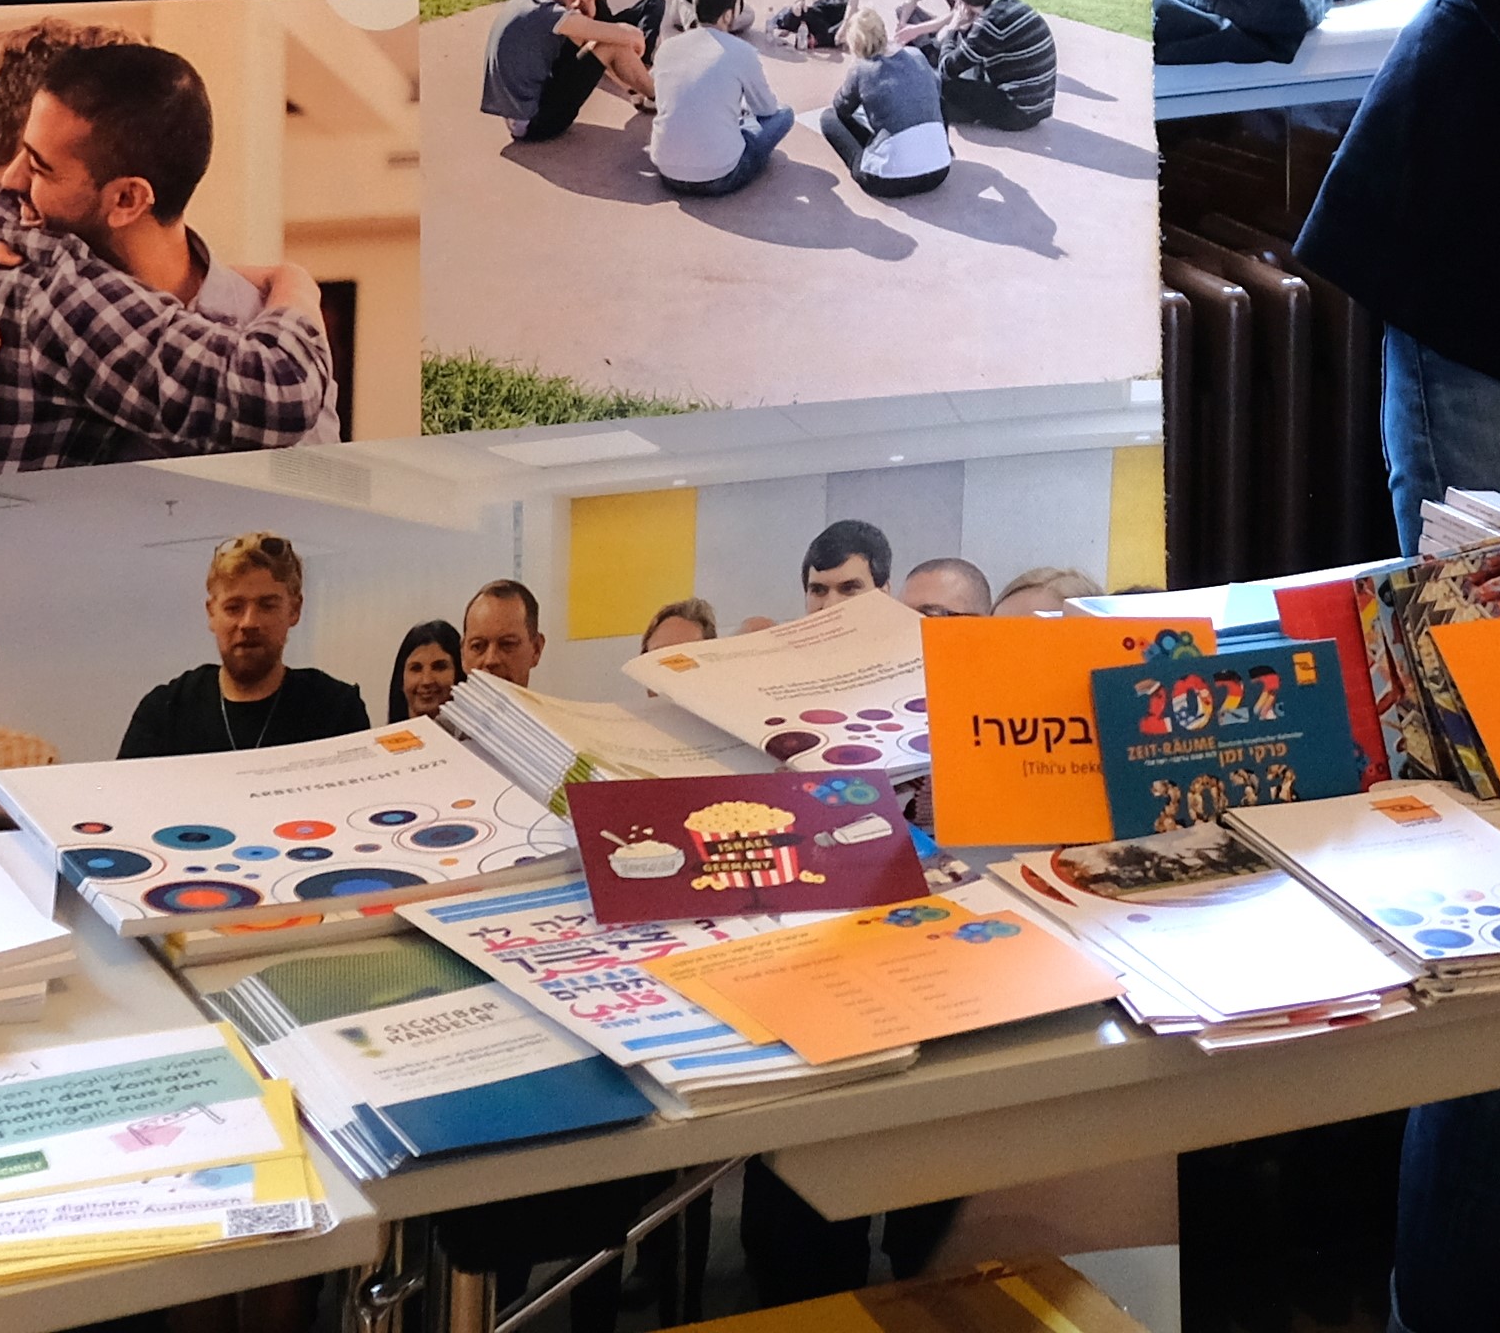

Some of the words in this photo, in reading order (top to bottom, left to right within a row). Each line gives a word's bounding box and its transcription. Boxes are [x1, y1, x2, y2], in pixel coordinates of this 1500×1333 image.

[1133, 665, 1284, 734] 2022
[1127, 735, 1217, 762] ZEIT-RÄUME
[249, 770, 402, 798] ARBEITSBERICHT
[717, 837, 773, 853] ISRAEL
[702, 859, 772, 874] GERMANY
[541, 967, 639, 991] STEIN
[383, 1001, 500, 1036] SICHTBAR
[386, 1013, 496, 1046] HANDELN
[40, 1067, 152, 1094] möglichst
[59, 1089, 103, 1102] den
[110, 1070, 200, 1092] Kontakt
[116, 1090, 159, 1103] aus
[166, 1079, 218, 1094] dem
